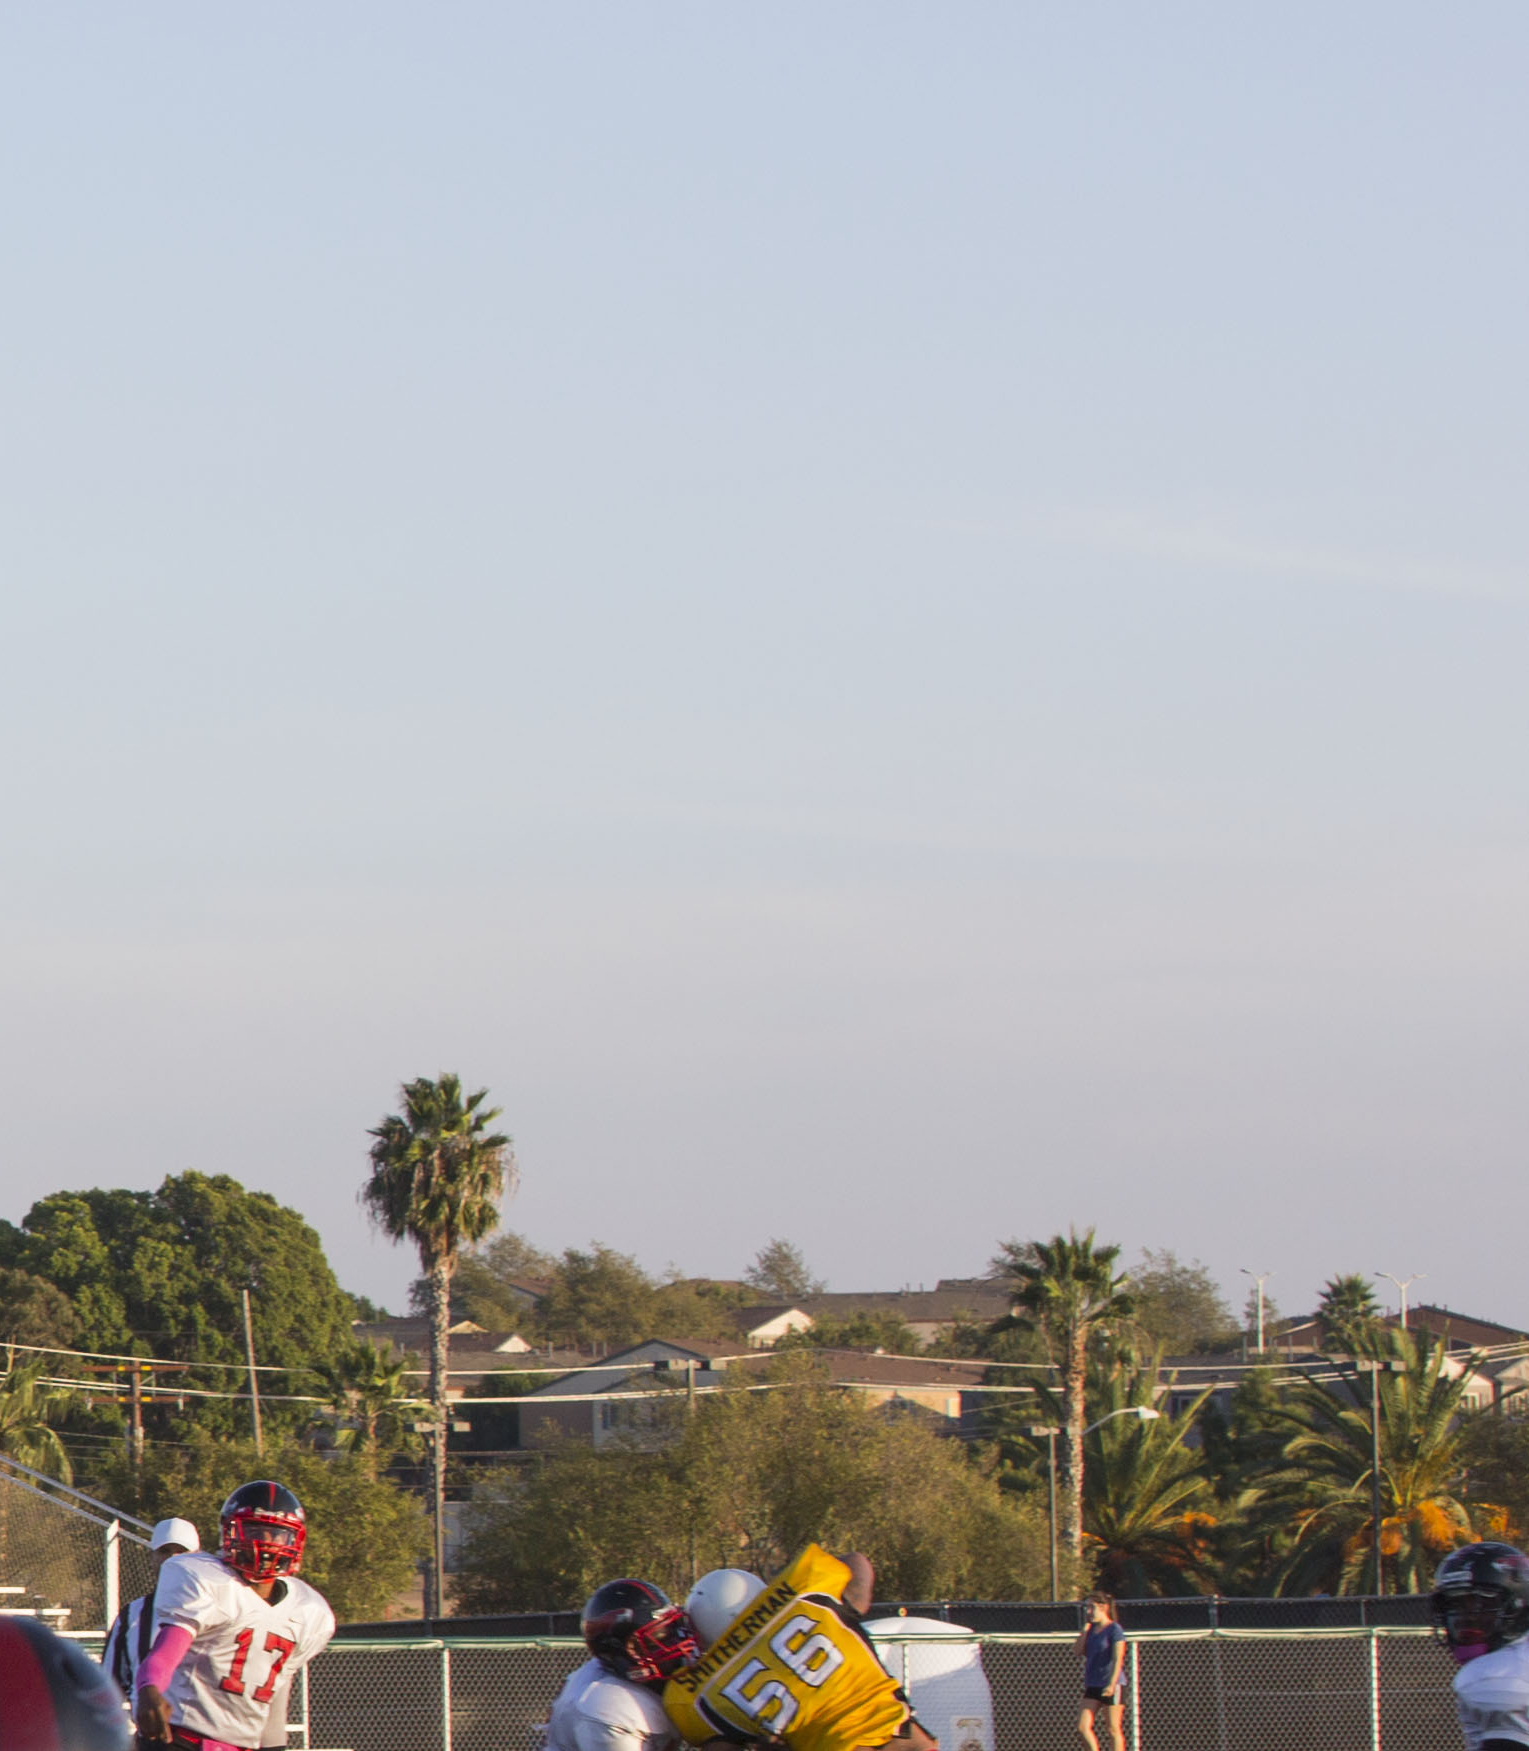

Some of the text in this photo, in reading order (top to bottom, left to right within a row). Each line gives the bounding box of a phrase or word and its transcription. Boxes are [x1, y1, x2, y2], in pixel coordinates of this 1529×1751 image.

[220, 1628, 296, 1703] 17
[675, 1582, 796, 1692] SMITHERMAN
[719, 1614, 845, 1735] 56
